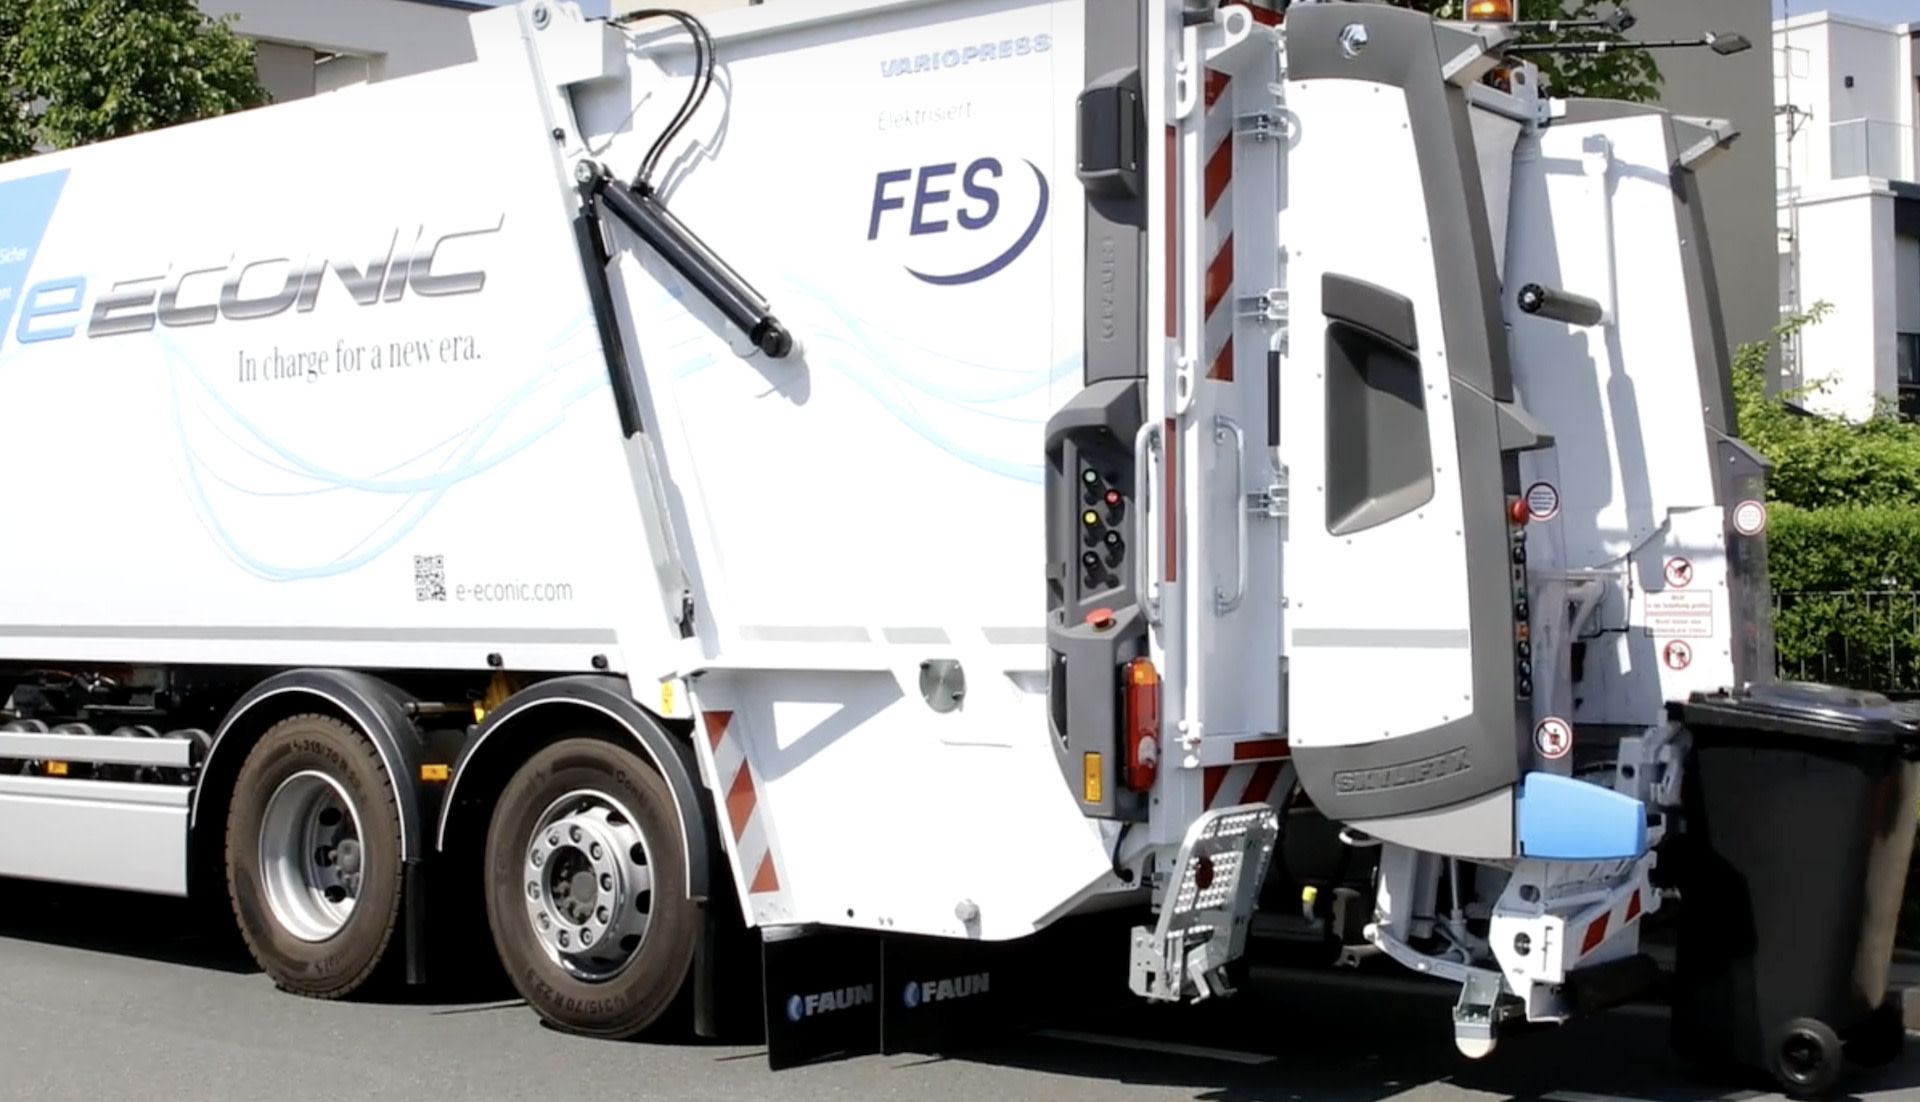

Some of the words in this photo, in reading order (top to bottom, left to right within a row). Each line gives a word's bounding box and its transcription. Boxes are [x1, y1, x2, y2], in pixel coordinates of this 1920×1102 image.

[880, 33, 1053, 78] VARIOPRESS
[867, 156, 1003, 241] FES
[238, 350, 257, 382] In
[263, 346, 329, 384] charge
[335, 338, 366, 373] for
[370, 344, 382, 370] a
[389, 338, 434, 368] new
[439, 334, 482, 363] era.
[455, 578, 573, 601] e-econic.com
[804, 983, 874, 1016] FAUN
[921, 972, 990, 1003] FAUN
